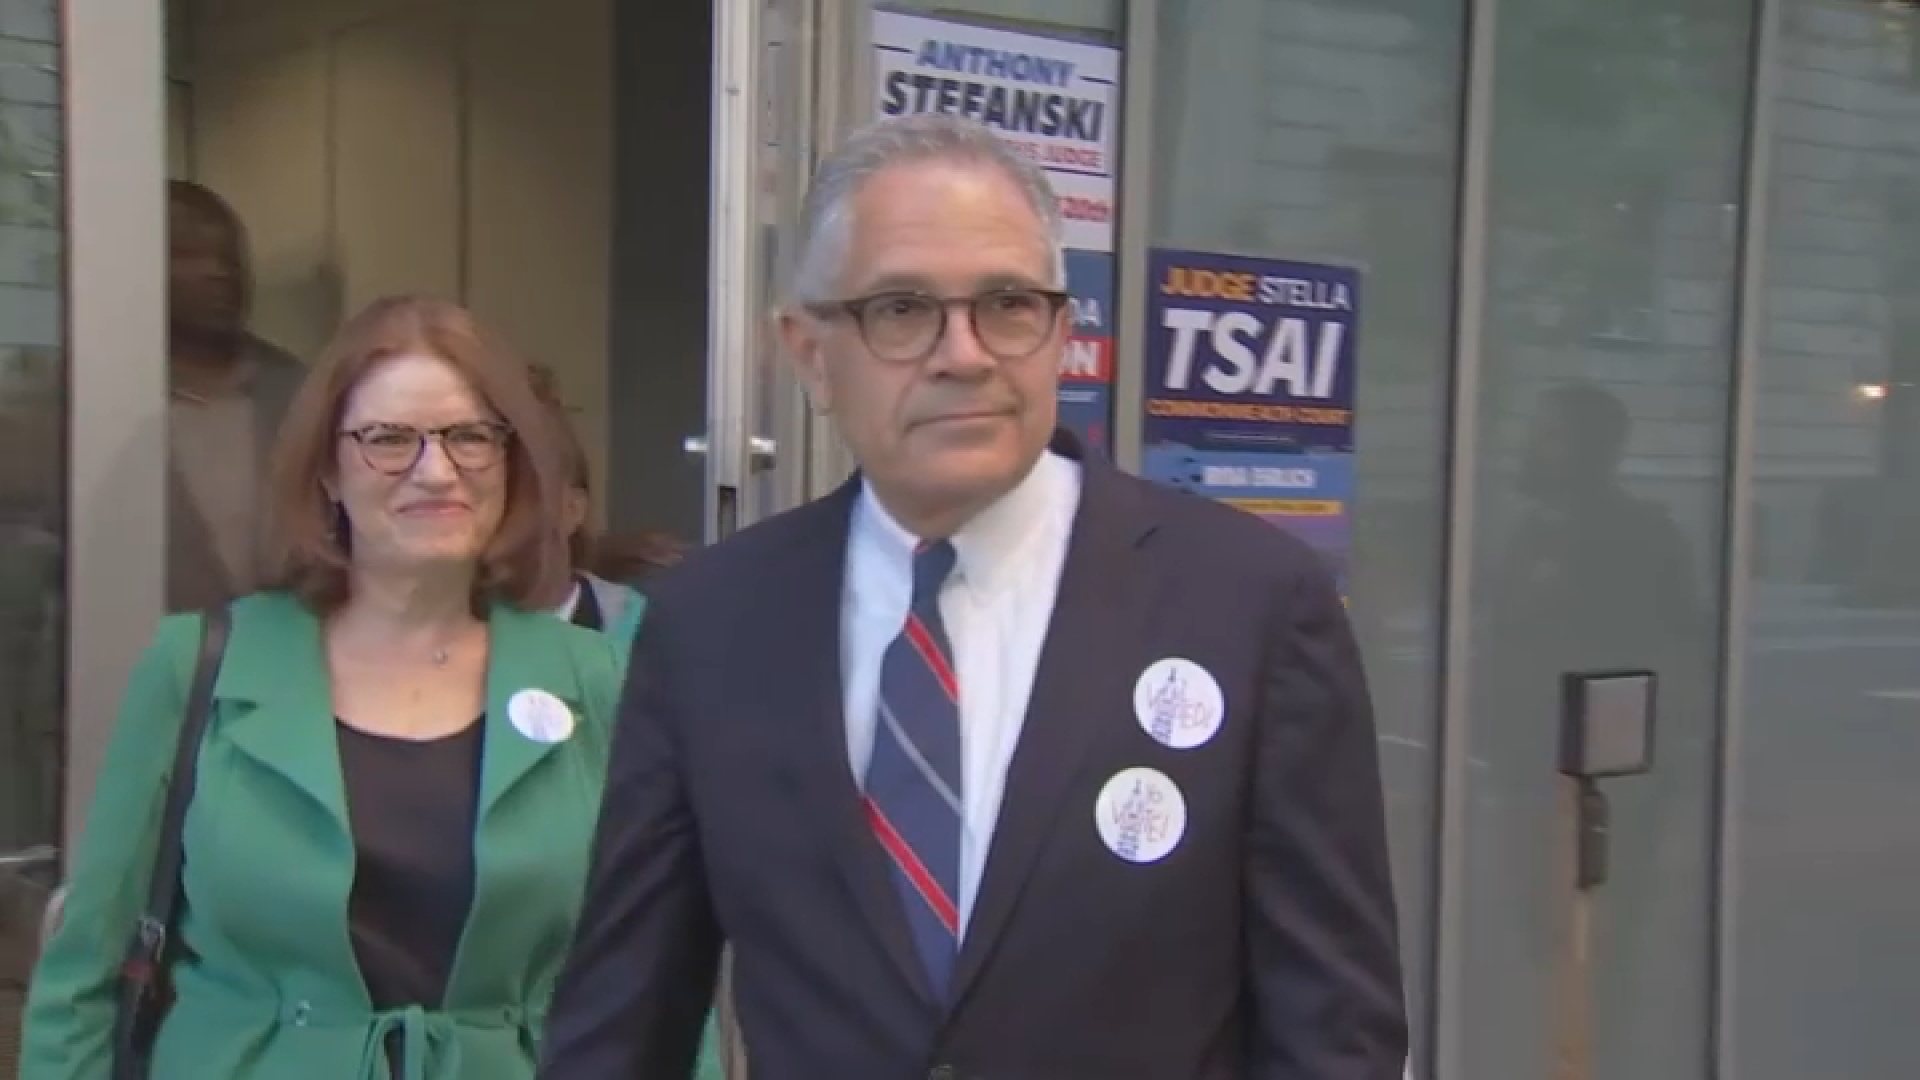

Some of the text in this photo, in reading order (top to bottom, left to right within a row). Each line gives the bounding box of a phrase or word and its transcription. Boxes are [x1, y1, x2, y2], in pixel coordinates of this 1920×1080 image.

[917, 39, 1075, 87] ANTHONY
[883, 71, 1104, 142] STEFANSKI
[1160, 267, 1352, 311] JUDGE STELLA
[1162, 307, 1345, 399] TSAI
